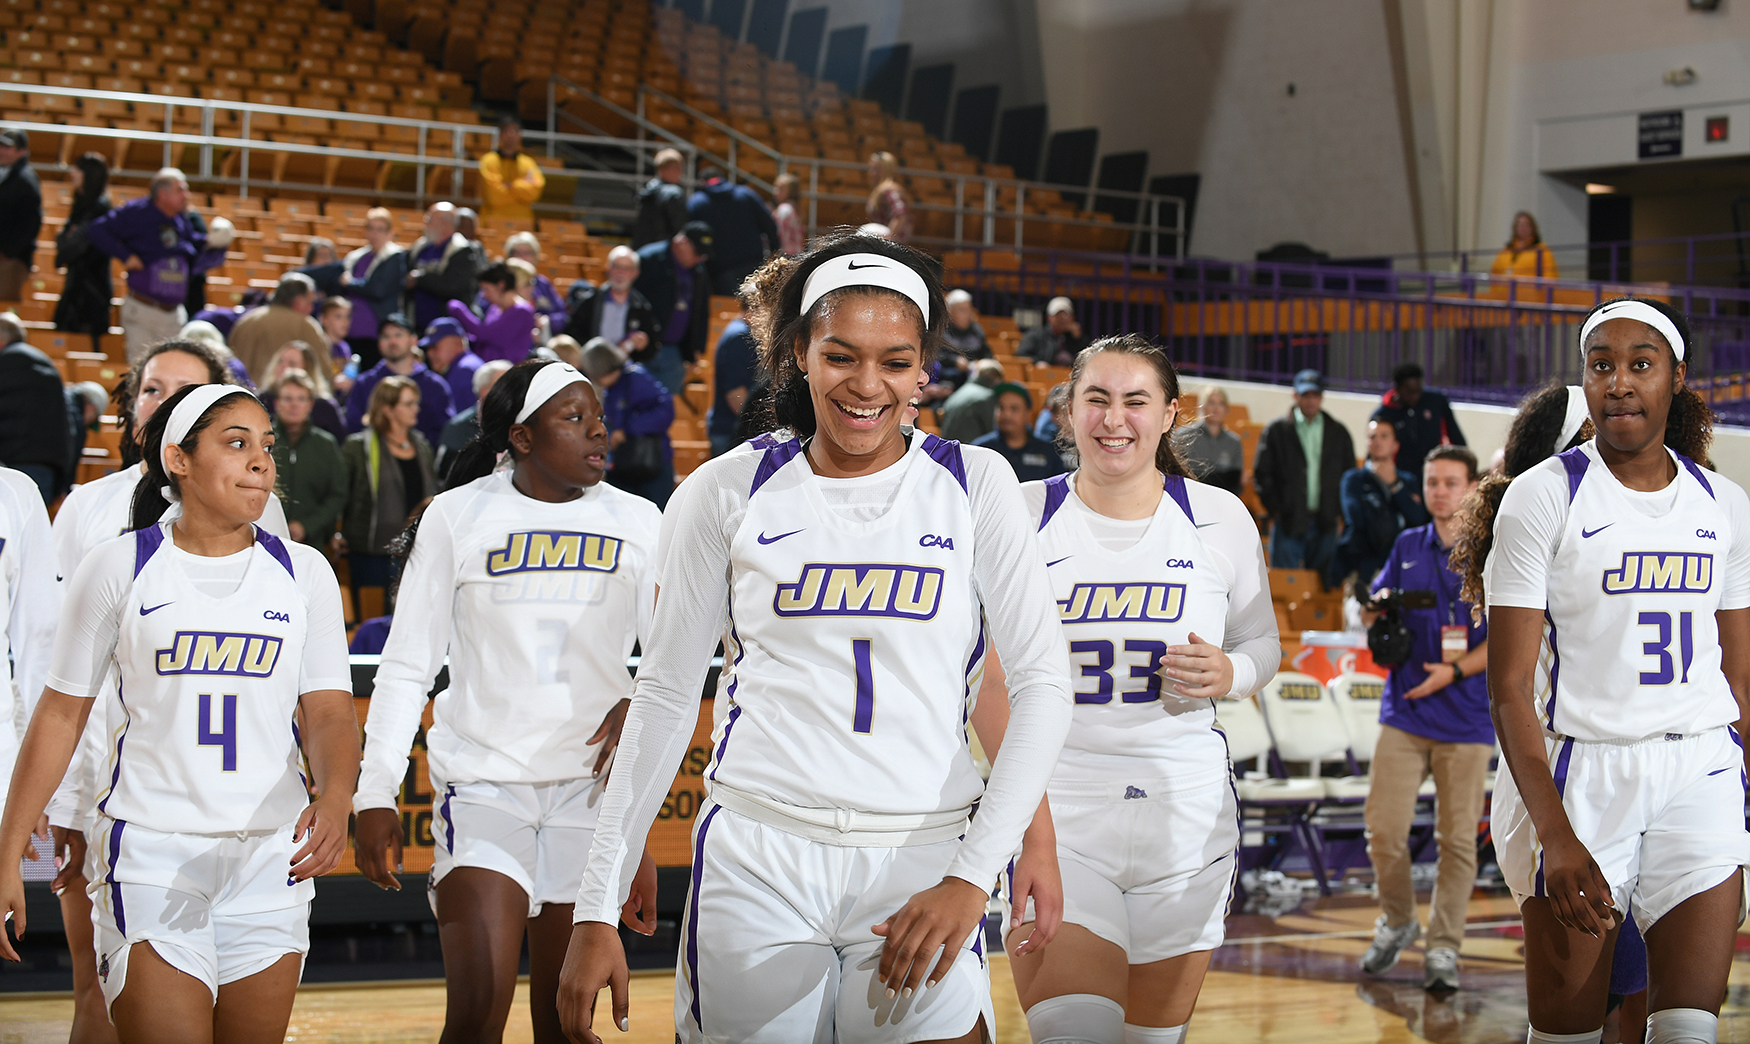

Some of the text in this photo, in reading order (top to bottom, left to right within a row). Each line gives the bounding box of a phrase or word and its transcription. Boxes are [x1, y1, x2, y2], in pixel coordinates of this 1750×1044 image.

[486, 531, 625, 577] JMU
[919, 534, 954, 550] CAA
[1696, 528, 1717, 541] CAA
[1166, 558, 1194, 569] CAA
[1602, 551, 1714, 595] JMU
[773, 563, 946, 622] JMU
[1057, 582, 1188, 624] JMU
[263, 610, 290, 623] CAA
[155, 630, 284, 680] JMU
[1637, 610, 1695, 687] 31
[851, 638, 875, 735] 1
[1069, 638, 1169, 705] 33
[1279, 682, 1321, 700] JMU
[197, 692, 239, 773] 4
